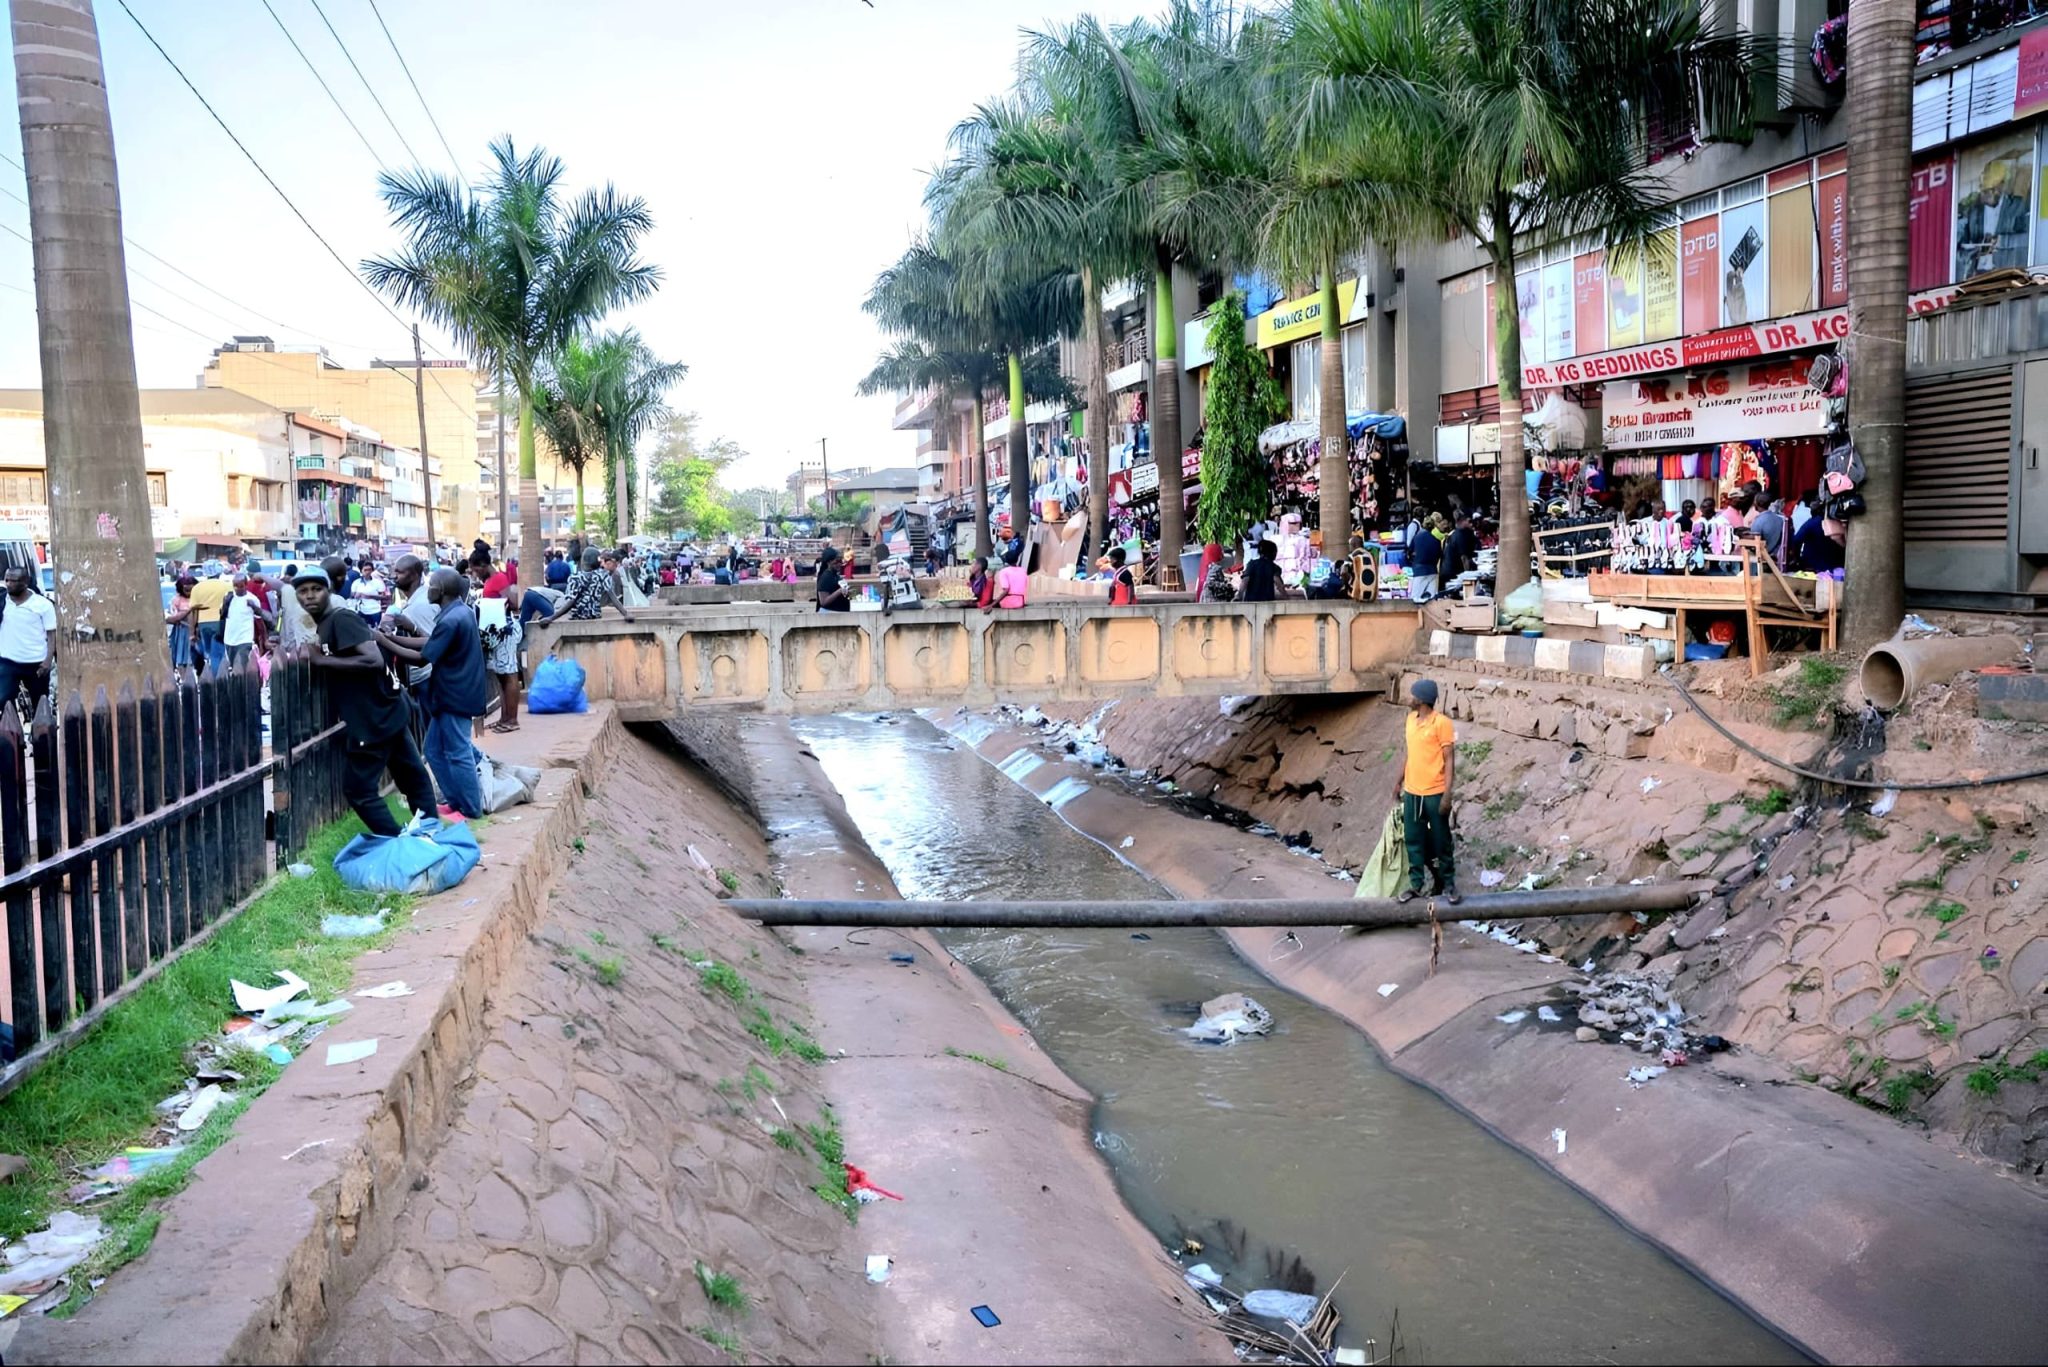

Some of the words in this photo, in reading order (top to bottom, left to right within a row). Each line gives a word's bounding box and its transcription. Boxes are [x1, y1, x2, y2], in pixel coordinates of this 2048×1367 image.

[1911, 163, 1947, 191] TB
[1684, 231, 1717, 257] DTB
[1577, 266, 1603, 286] DTB
[1764, 324, 1807, 350] DR.
[1812, 315, 1849, 342] KG
[1525, 367, 1553, 385] DR.
[1555, 364, 1580, 382] KG
[1583, 347, 1678, 378] BEDDINGS
